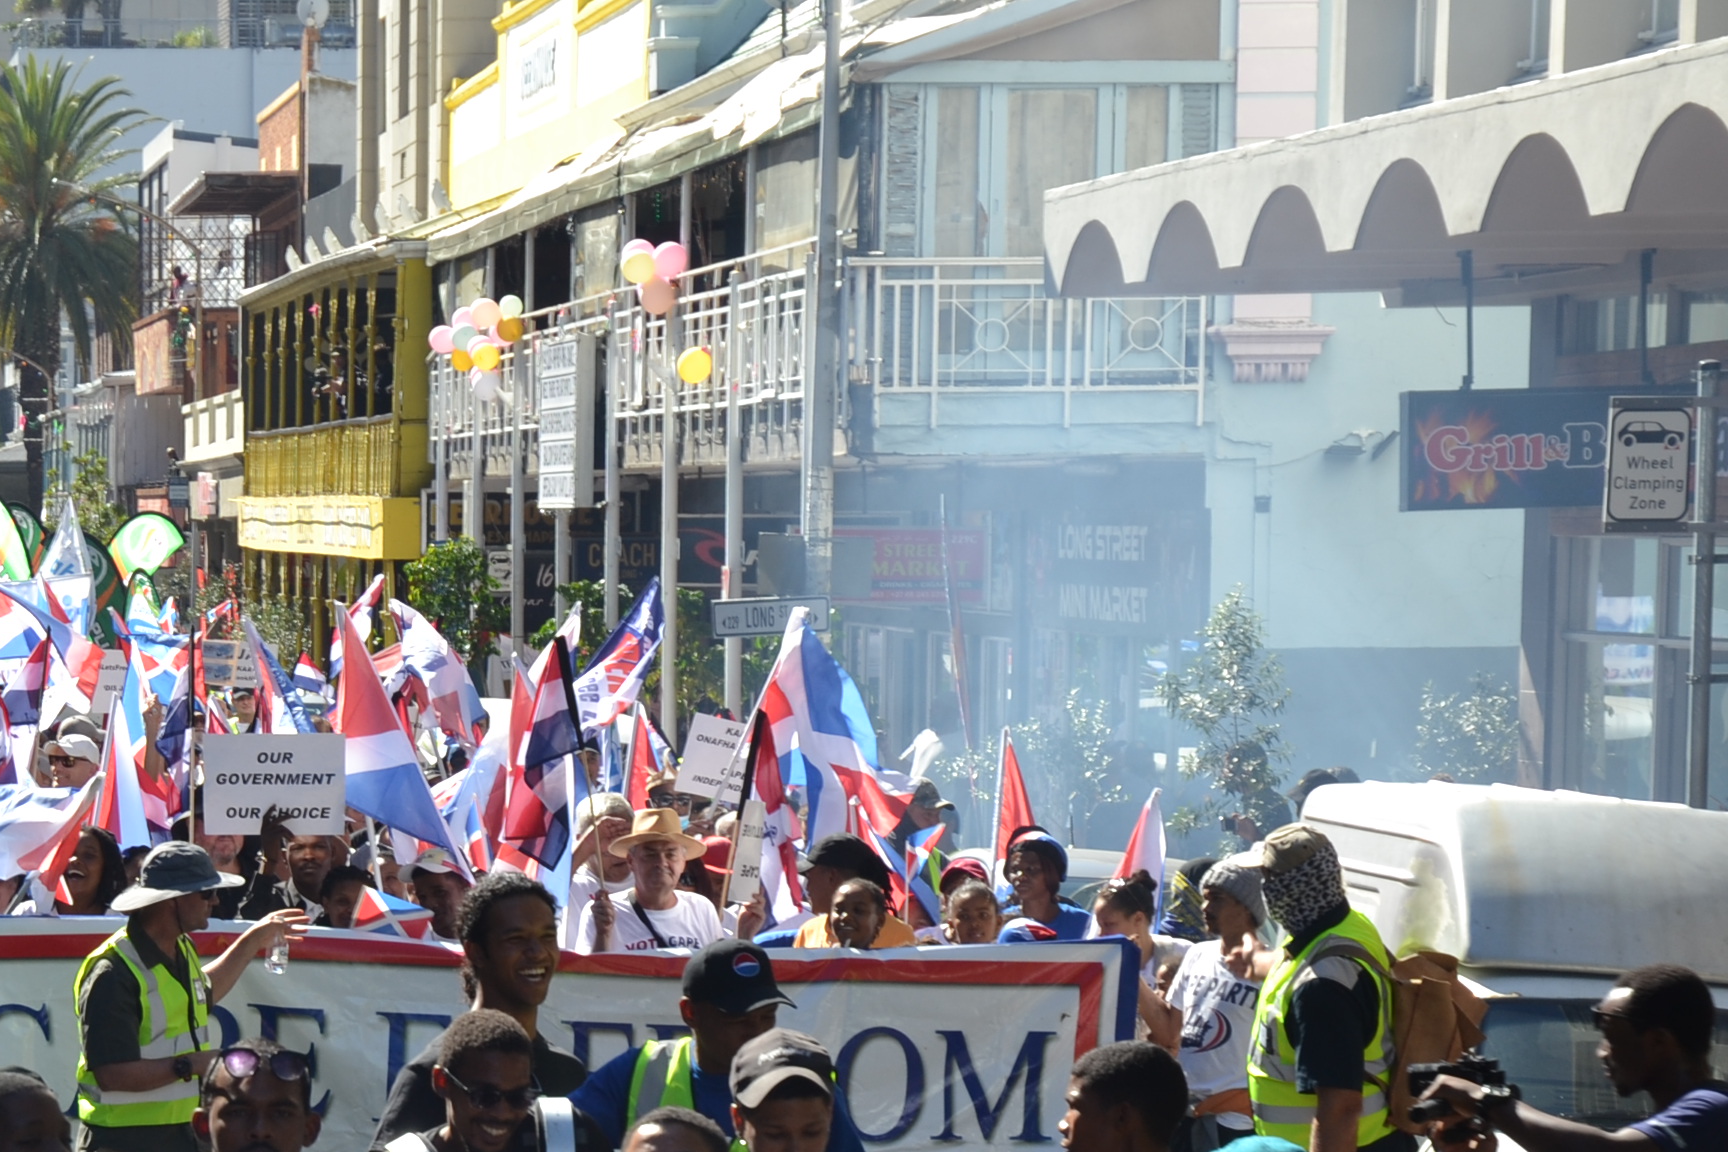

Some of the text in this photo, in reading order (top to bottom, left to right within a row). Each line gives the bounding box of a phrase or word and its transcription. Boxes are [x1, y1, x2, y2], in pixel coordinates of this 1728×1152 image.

[1626, 456, 1674, 469] Wheel
[1613, 476, 1684, 492] Clamping
[1629, 496, 1666, 510] Zone
[1058, 524, 1148, 561] LONG STREET
[588, 543, 656, 567] CACH
[871, 560, 969, 576] MARKT
[1059, 583, 1148, 623] MINI MARKET
[745, 605, 776, 628] LONG
[779, 603, 789, 618] ST
[696, 734, 737, 750] ONAFHA
[257, 752, 294, 765] OUR
[216, 773, 336, 786] GOVERNMENT
[226, 807, 261, 820] OUR
[625, 937, 657, 951] VOT
